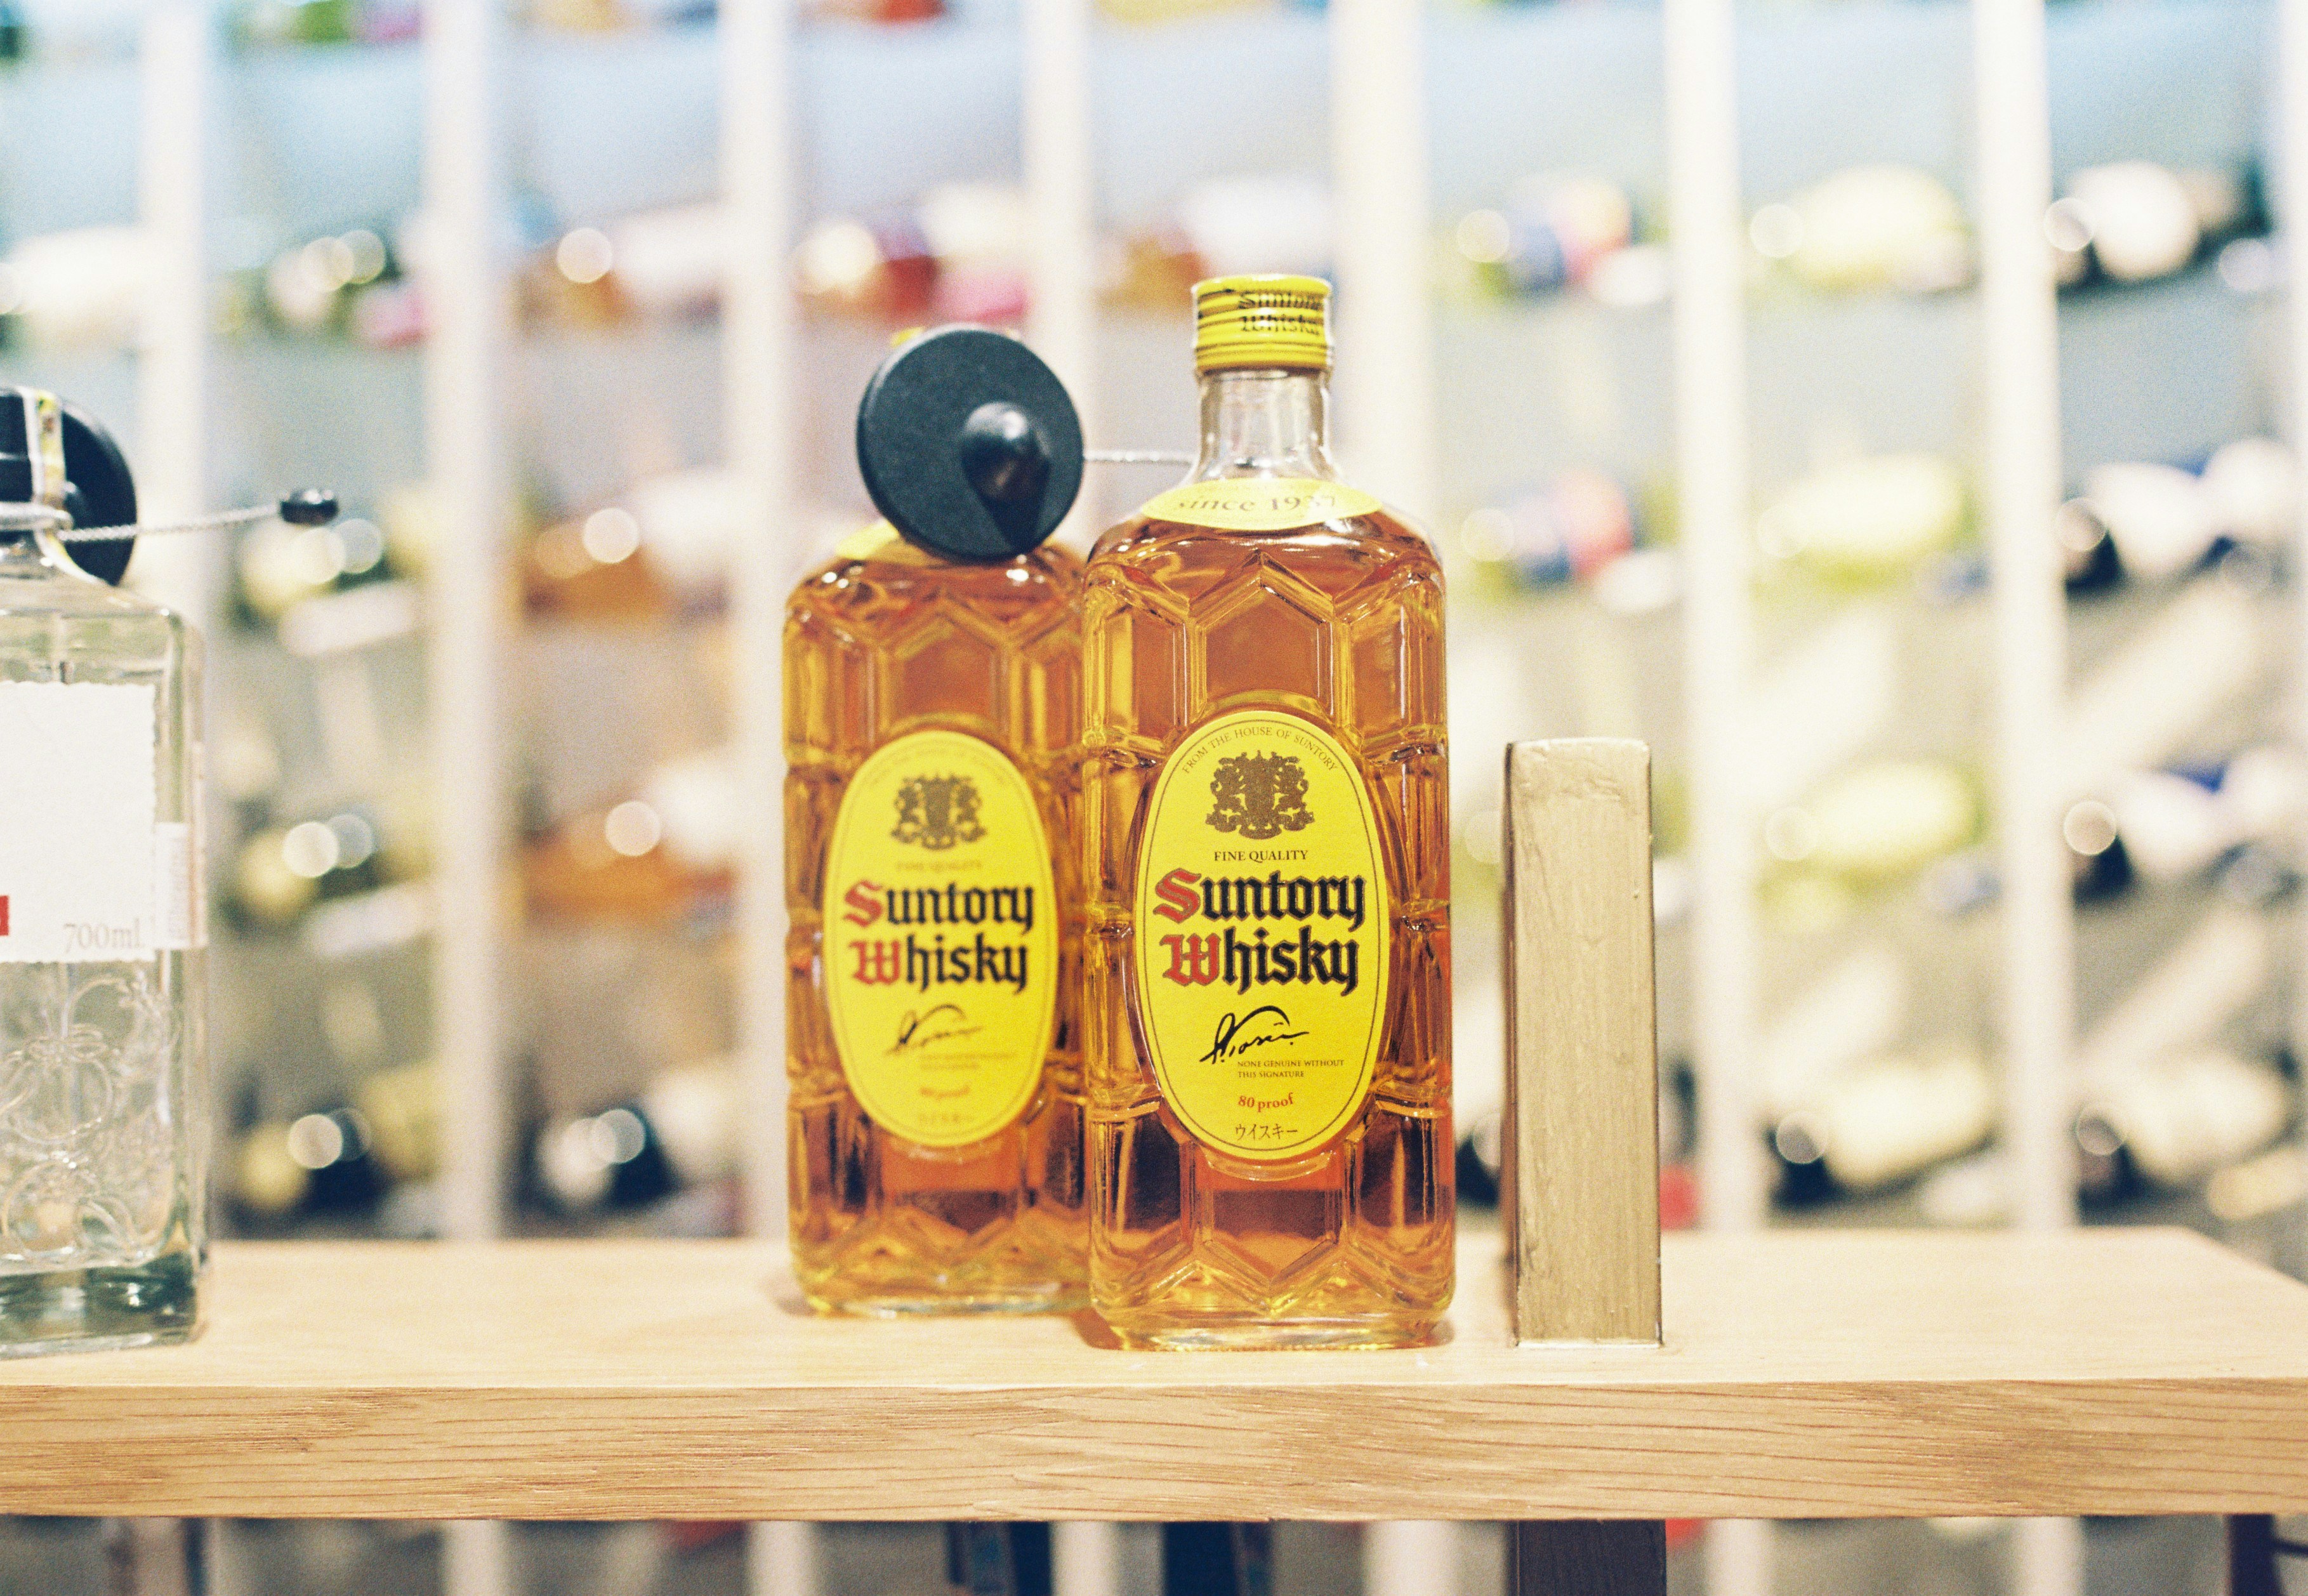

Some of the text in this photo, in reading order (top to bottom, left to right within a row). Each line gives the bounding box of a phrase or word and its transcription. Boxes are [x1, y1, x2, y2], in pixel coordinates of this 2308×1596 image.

[1182, 727, 1338, 774] FROM THE HOUSE OF SUNTORY
[1214, 850, 1309, 863] FINE QUALITY
[842, 880, 1034, 936] Suntory
[1152, 867, 1368, 933] Suntory
[848, 932, 1028, 995] Whisky
[1159, 925, 1361, 997] Whisky
[1238, 1091, 1294, 1113] 80 proof
[1235, 1123, 1298, 1141] ウイスキー
